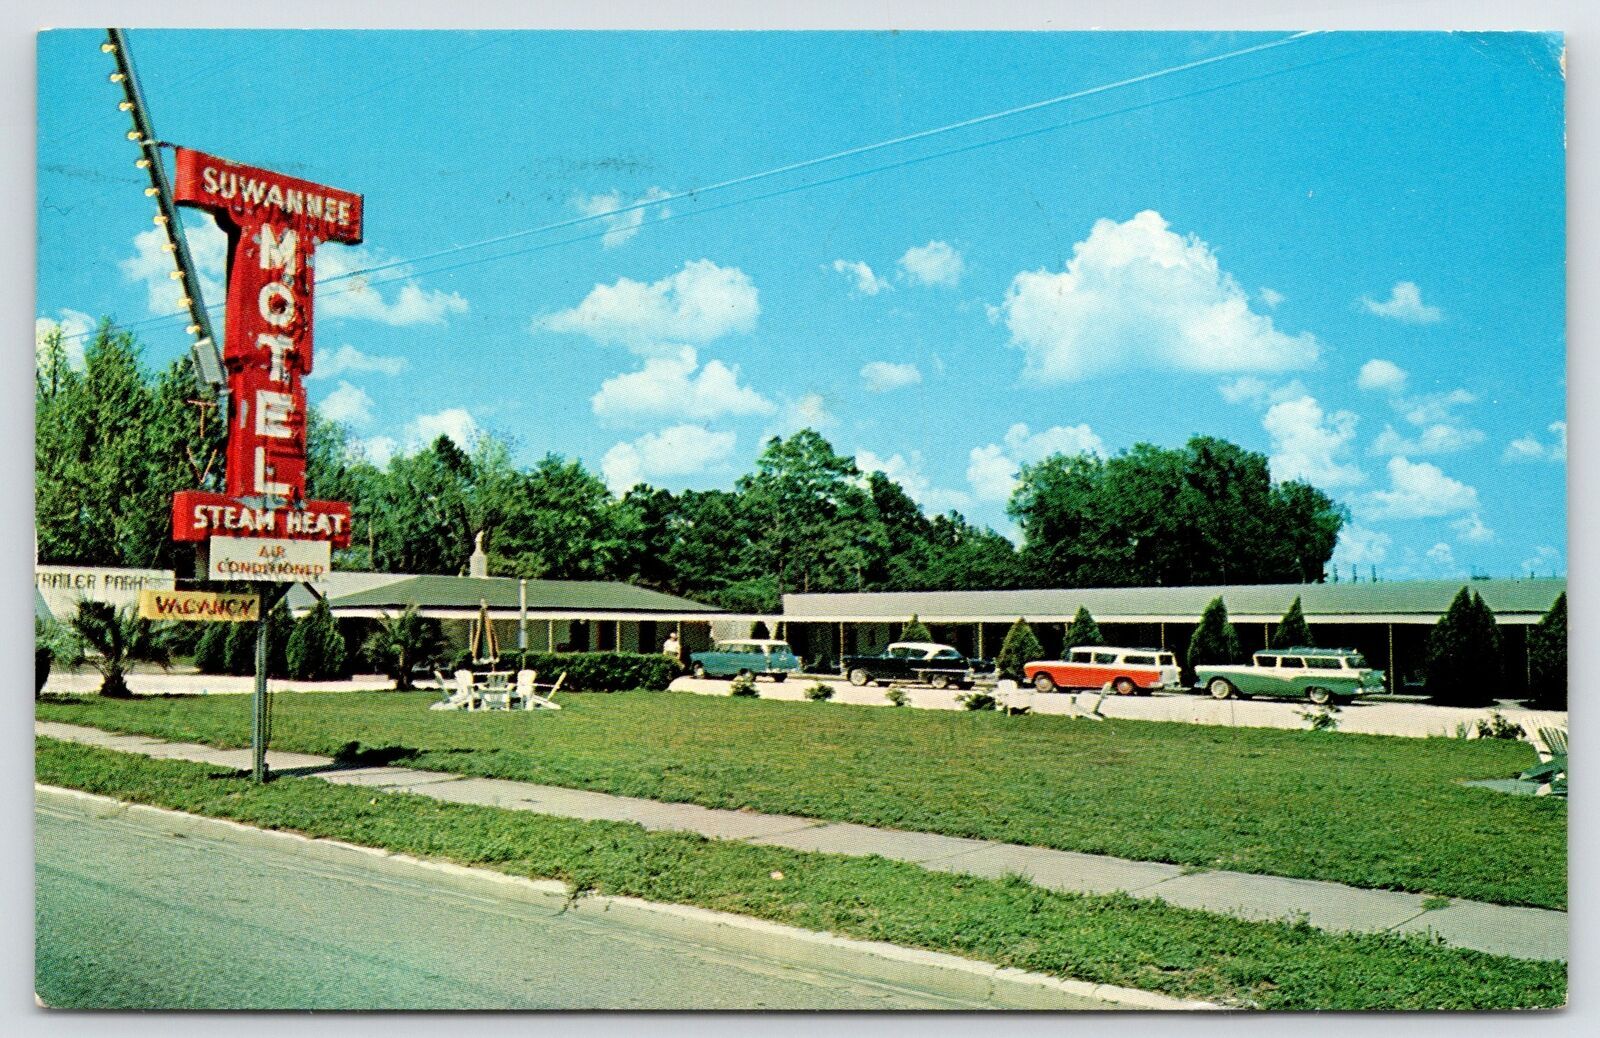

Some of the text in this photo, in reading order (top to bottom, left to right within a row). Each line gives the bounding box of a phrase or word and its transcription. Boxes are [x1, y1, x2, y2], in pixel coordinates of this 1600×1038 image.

[203, 166, 350, 226] SUWANNEE
[253, 222, 298, 495] MOTEL
[193, 505, 346, 535] STEAM HEAT
[259, 545, 286, 558] AIR
[216, 560, 324, 576] CONDITIONED
[155, 595, 255, 616] VACANCY
